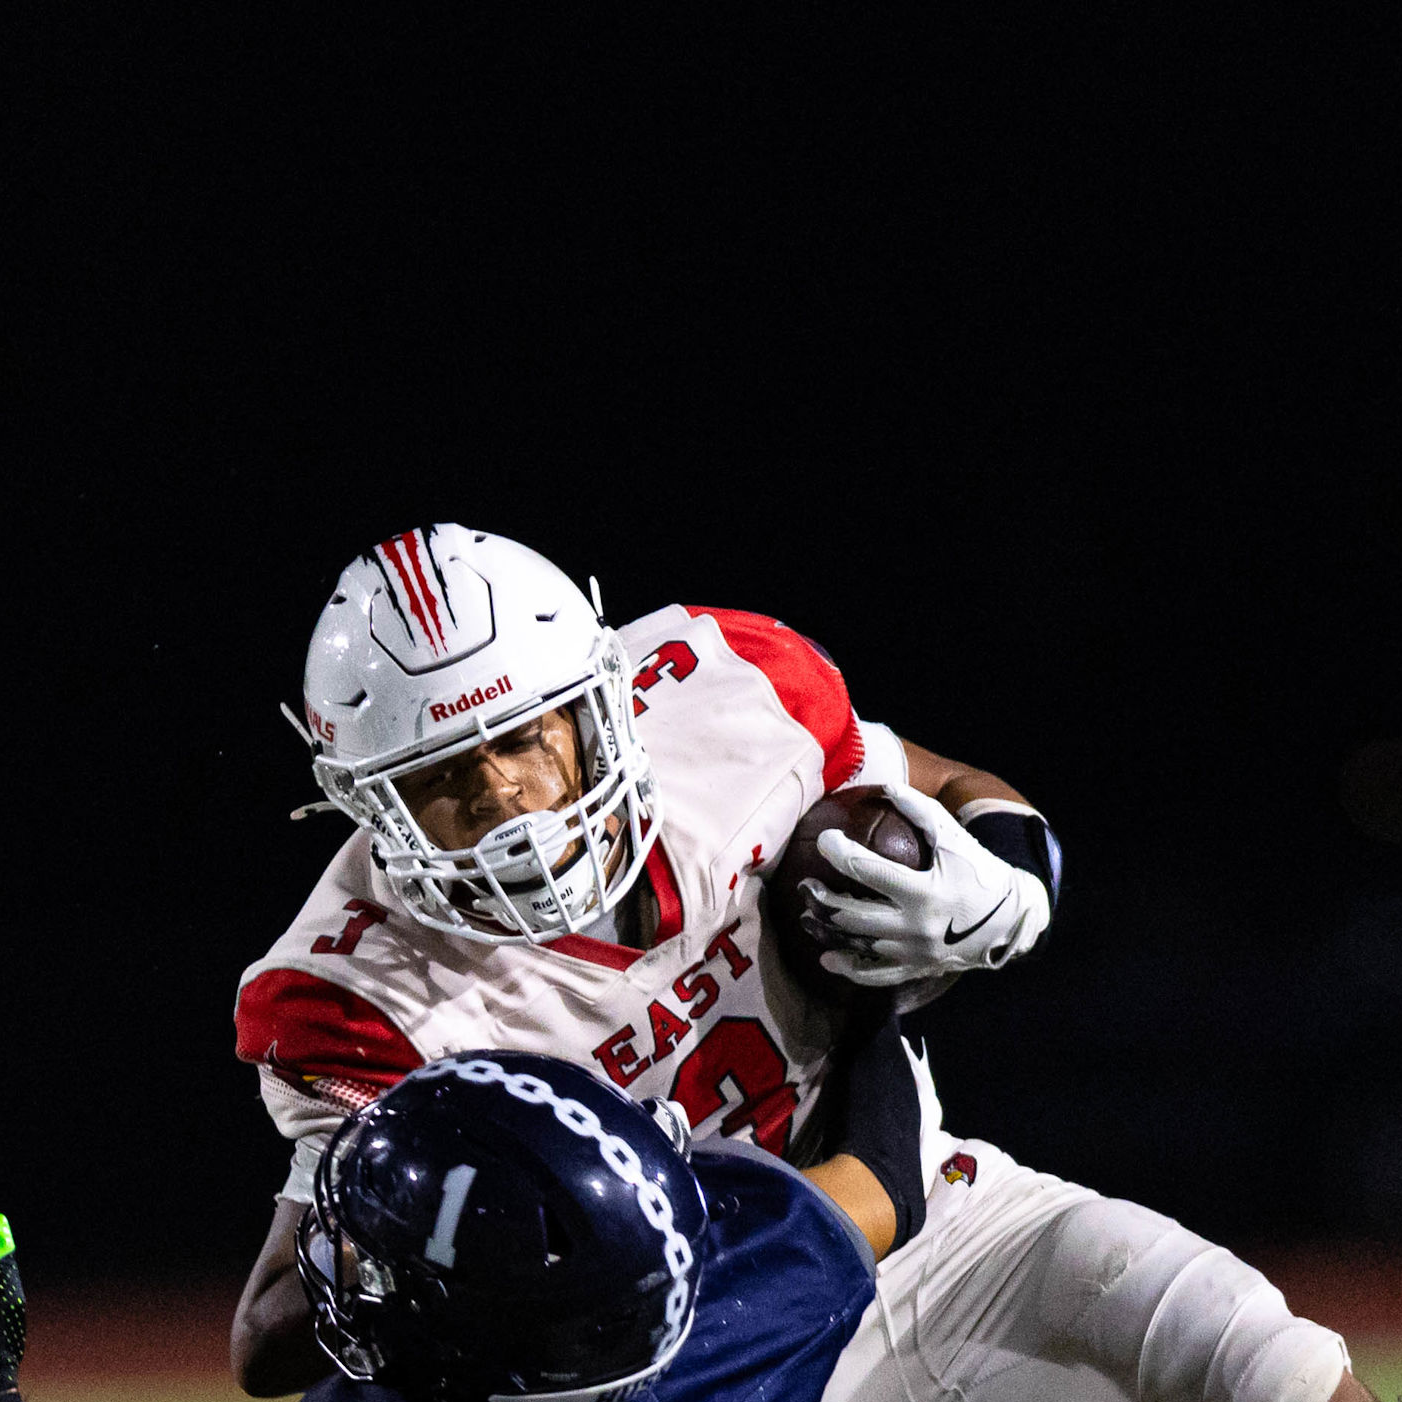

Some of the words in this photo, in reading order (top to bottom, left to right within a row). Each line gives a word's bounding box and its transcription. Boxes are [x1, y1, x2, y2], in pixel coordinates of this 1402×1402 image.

[430, 675, 514, 723] Riddell
[532, 886, 574, 911] Ridell
[592, 917, 757, 1091] EAST
[423, 1164, 477, 1269] 1
